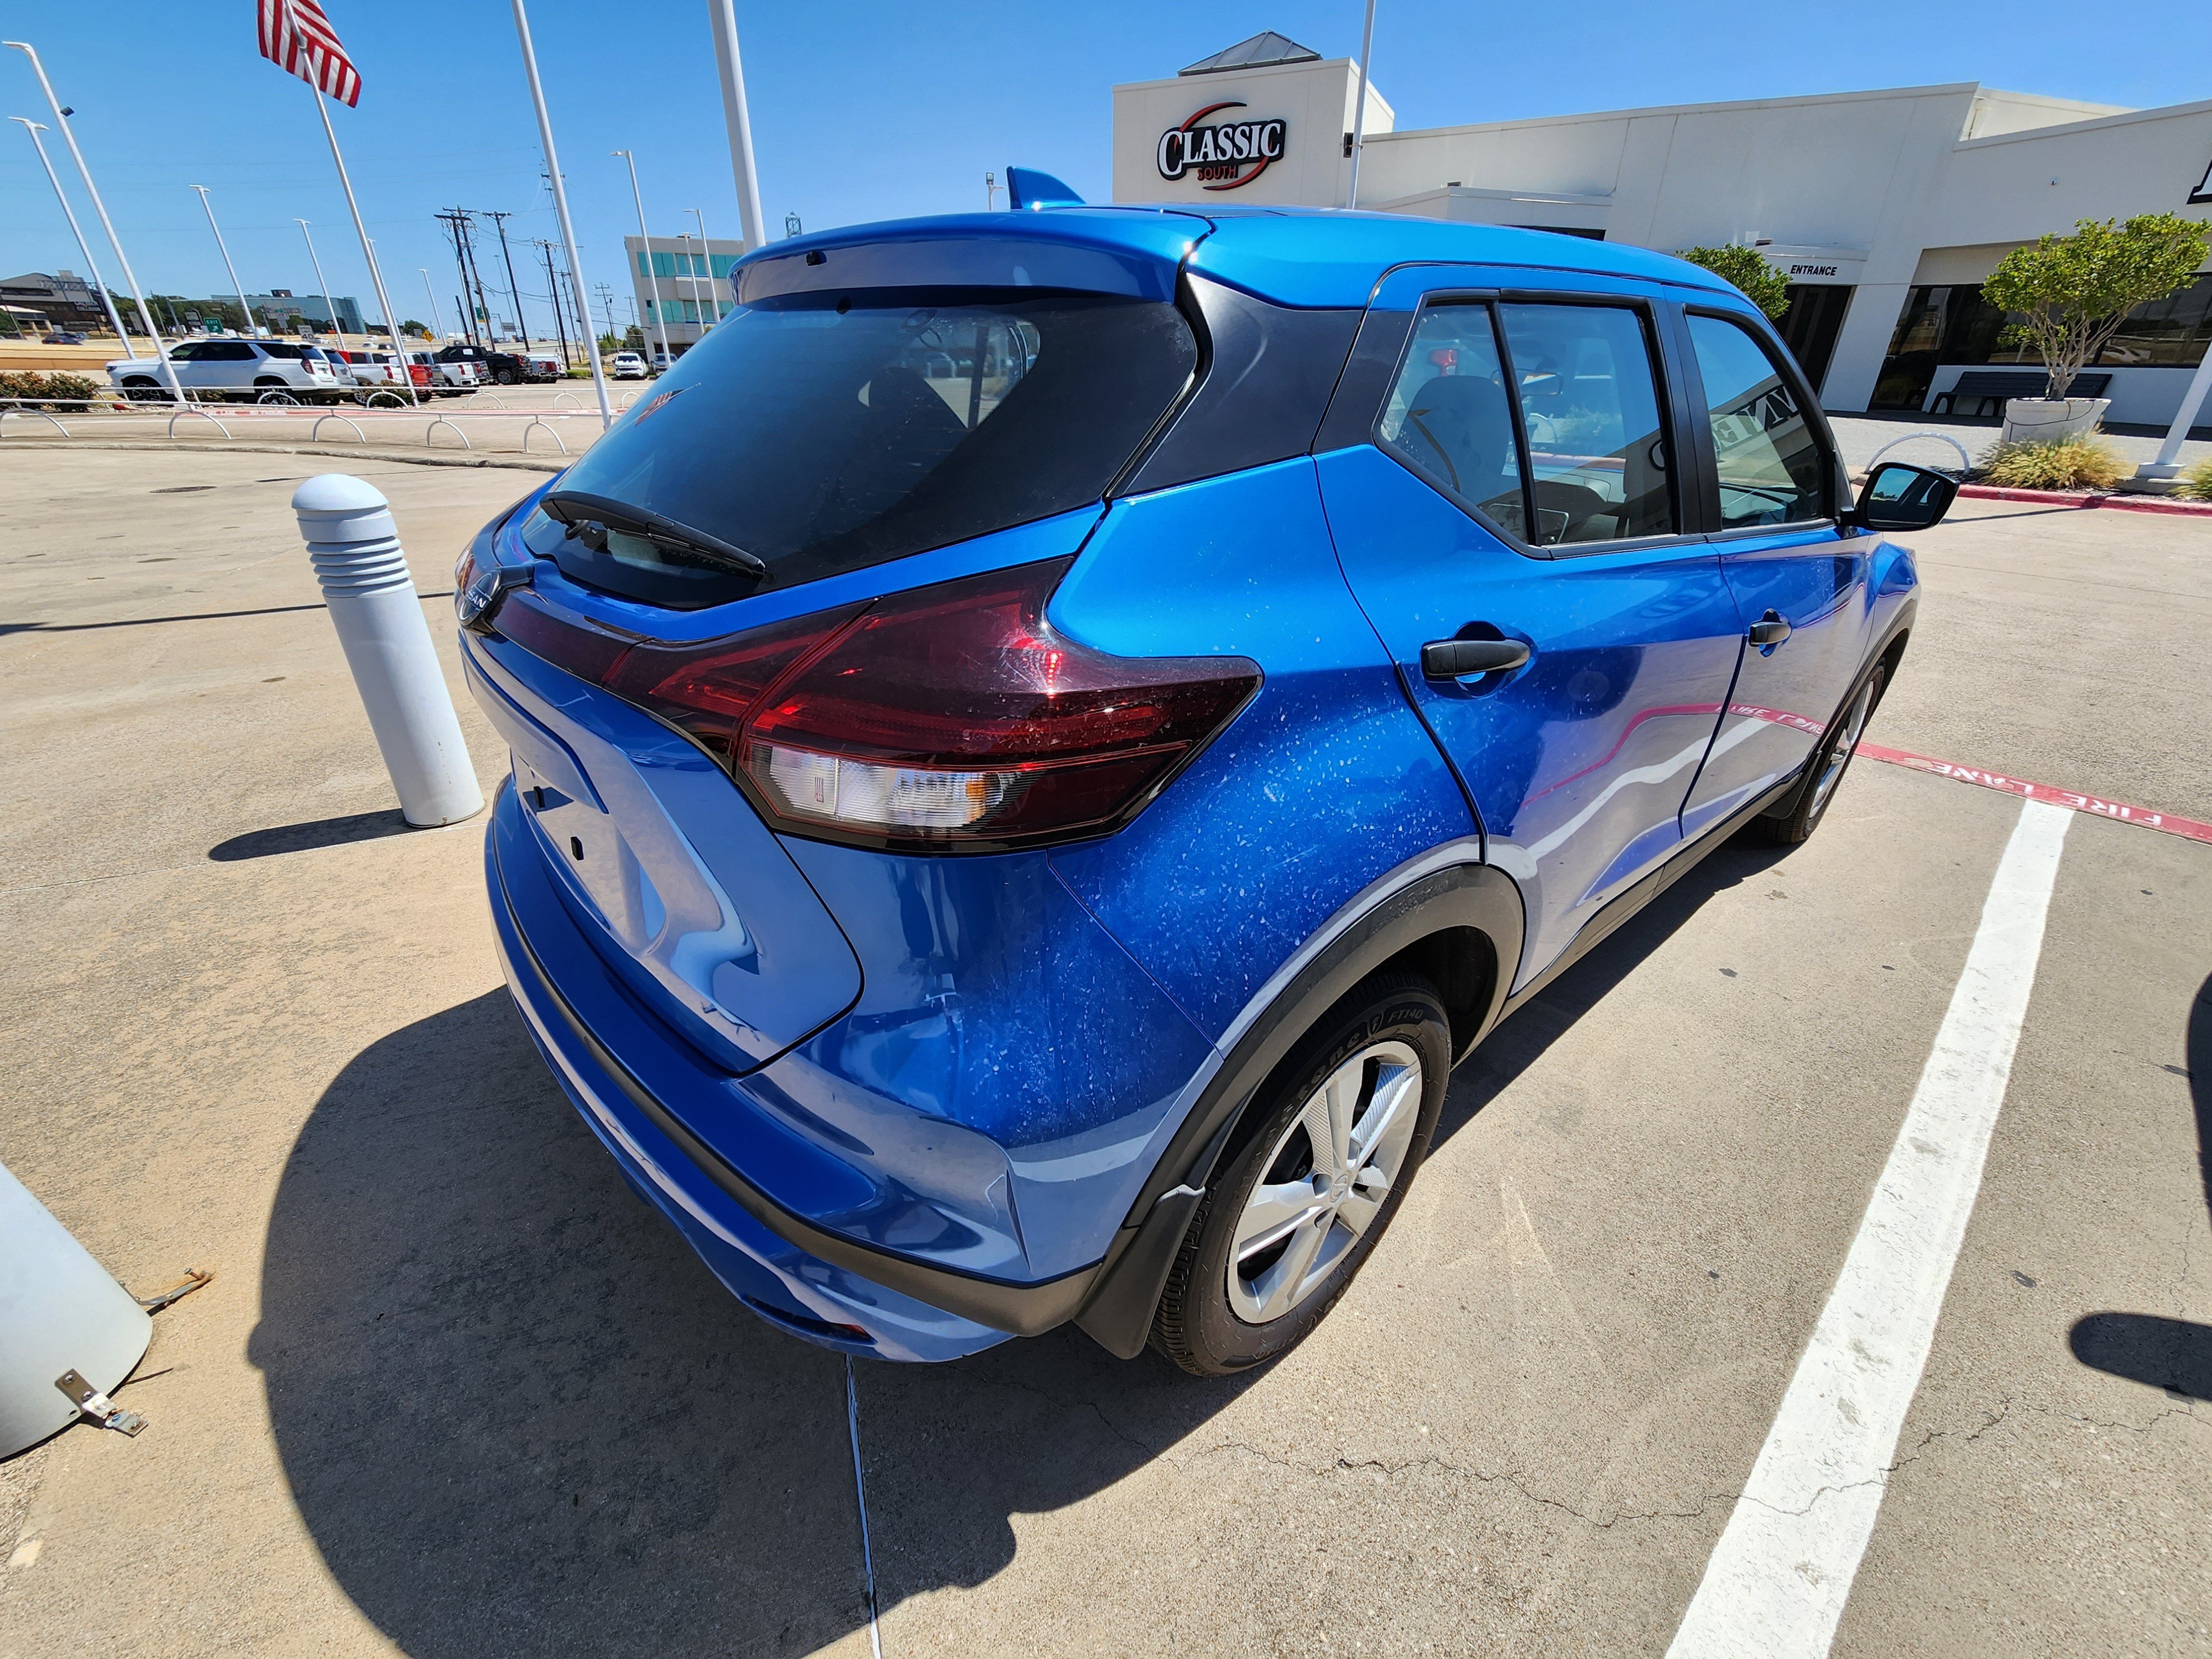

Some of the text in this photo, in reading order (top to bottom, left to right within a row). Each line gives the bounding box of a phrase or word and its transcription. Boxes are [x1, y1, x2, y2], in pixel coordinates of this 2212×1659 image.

[1159, 123, 1281, 175] CLASSIC
[1197, 164, 1238, 181] SOUTH
[1790, 264, 1837, 276] ENTRANCE
[1927, 761, 2162, 826] FIRE LANE
